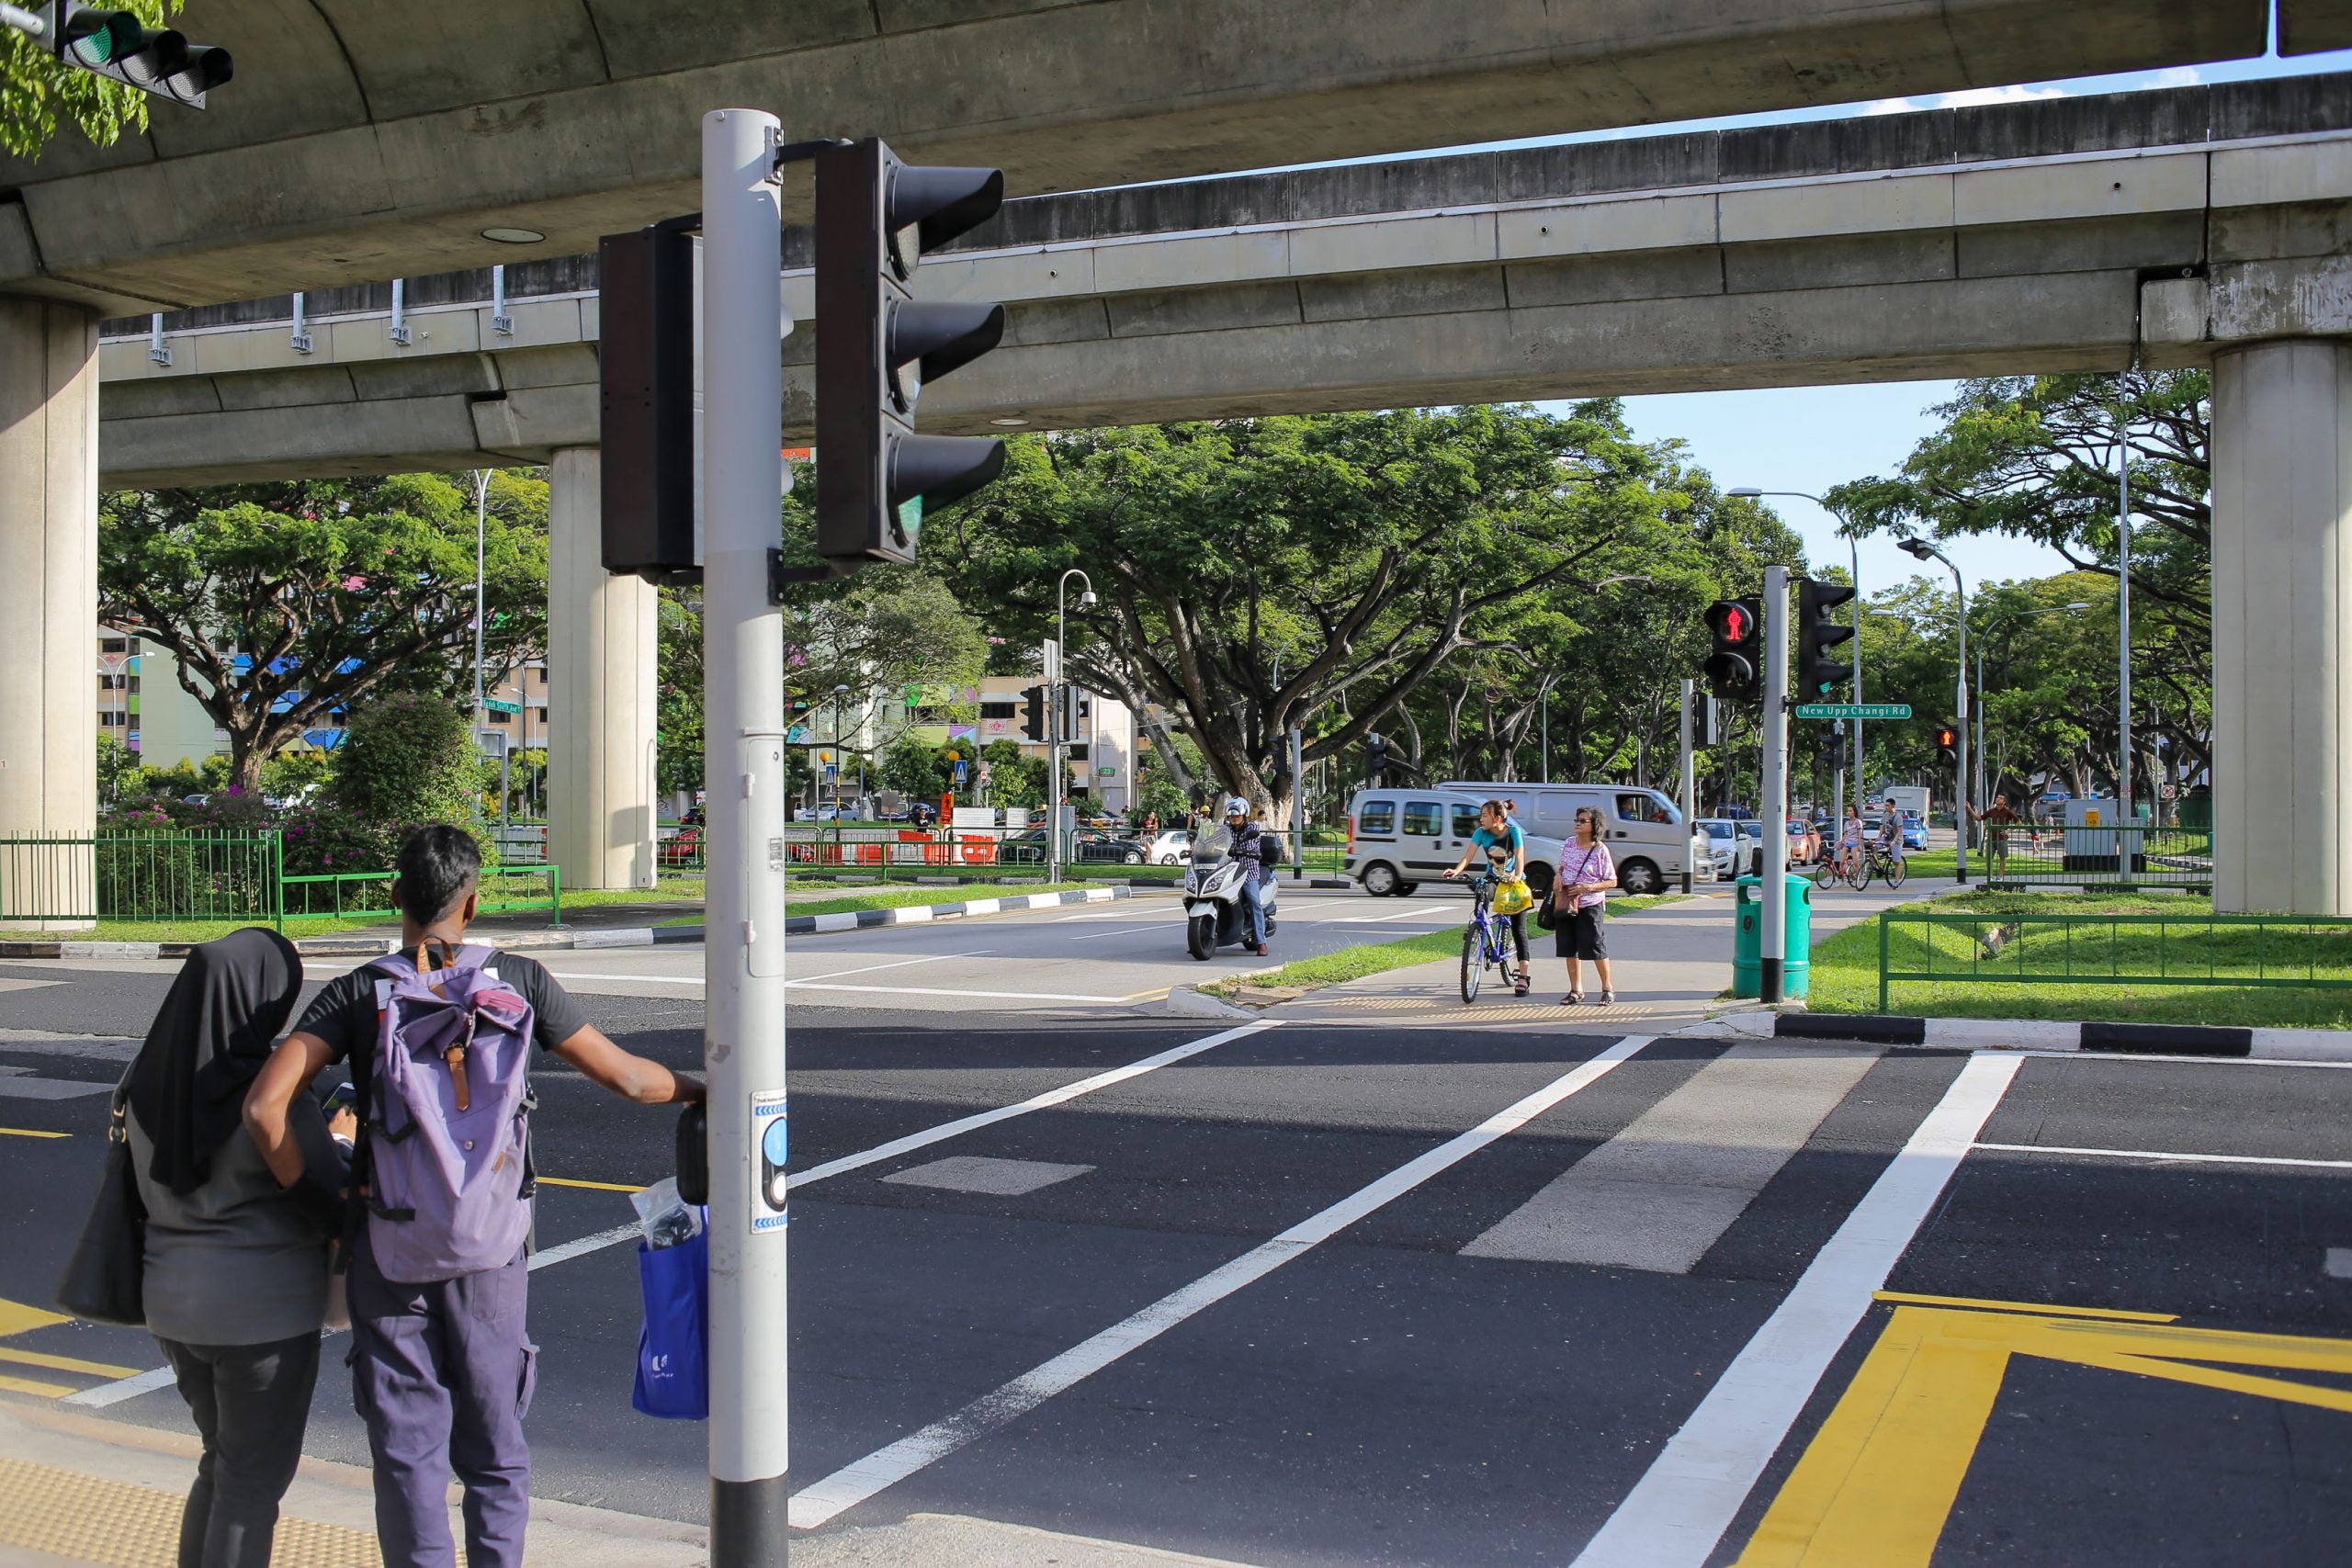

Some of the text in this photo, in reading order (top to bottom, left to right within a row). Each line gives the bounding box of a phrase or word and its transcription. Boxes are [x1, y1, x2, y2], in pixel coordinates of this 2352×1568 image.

[1802, 705, 1905, 716] New Upp Changi Rd
